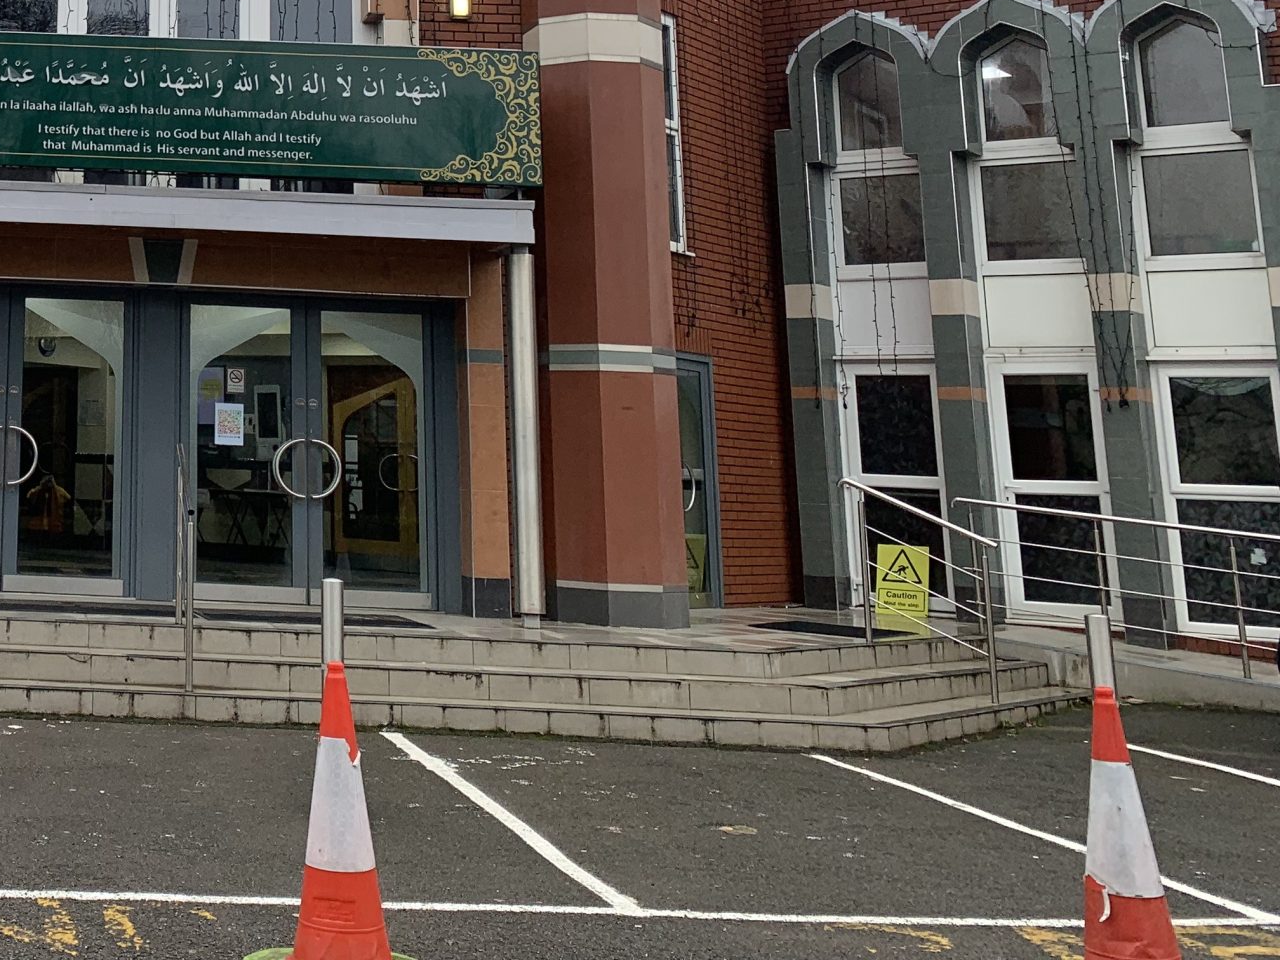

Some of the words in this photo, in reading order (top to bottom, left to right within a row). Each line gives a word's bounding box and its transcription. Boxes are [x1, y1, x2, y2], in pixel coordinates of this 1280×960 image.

[10, 99, 20, 110] la
[22, 100, 57, 111] ilaaha
[59, 101, 96, 114] ilallah,
[99, 104, 115, 113] wa
[118, 103, 137, 114] ash
[140, 104, 170, 115] hadu
[173, 107, 201, 116] anna
[204, 106, 287, 120] Muhammadan
[290, 110, 337, 122] Abduhu
[340, 114, 356, 123] wa
[359, 114, 417, 125] rasooluhu
[38, 124, 41, 133] I
[44, 124, 79, 136] testify
[83, 125, 106, 136] that
[108, 126, 138, 137] there
[141, 127, 150, 137] is
[156, 130, 170, 138] no
[173, 128, 197, 139] God
[200, 129, 220, 140] but
[223, 130, 252, 141] Allah
[255, 132, 276, 142] and
[280, 133, 282, 142] I
[286, 133, 321, 146] testify
[43, 139, 66, 150] that
[71, 140, 140, 152] Muhammad
[143, 142, 152, 153] is
[158, 143, 174, 154] His
[177, 145, 220, 155] servant
[223, 146, 245, 157] and
[248, 148, 313, 160] messenger.
[886, 591, 918, 600] Caution
